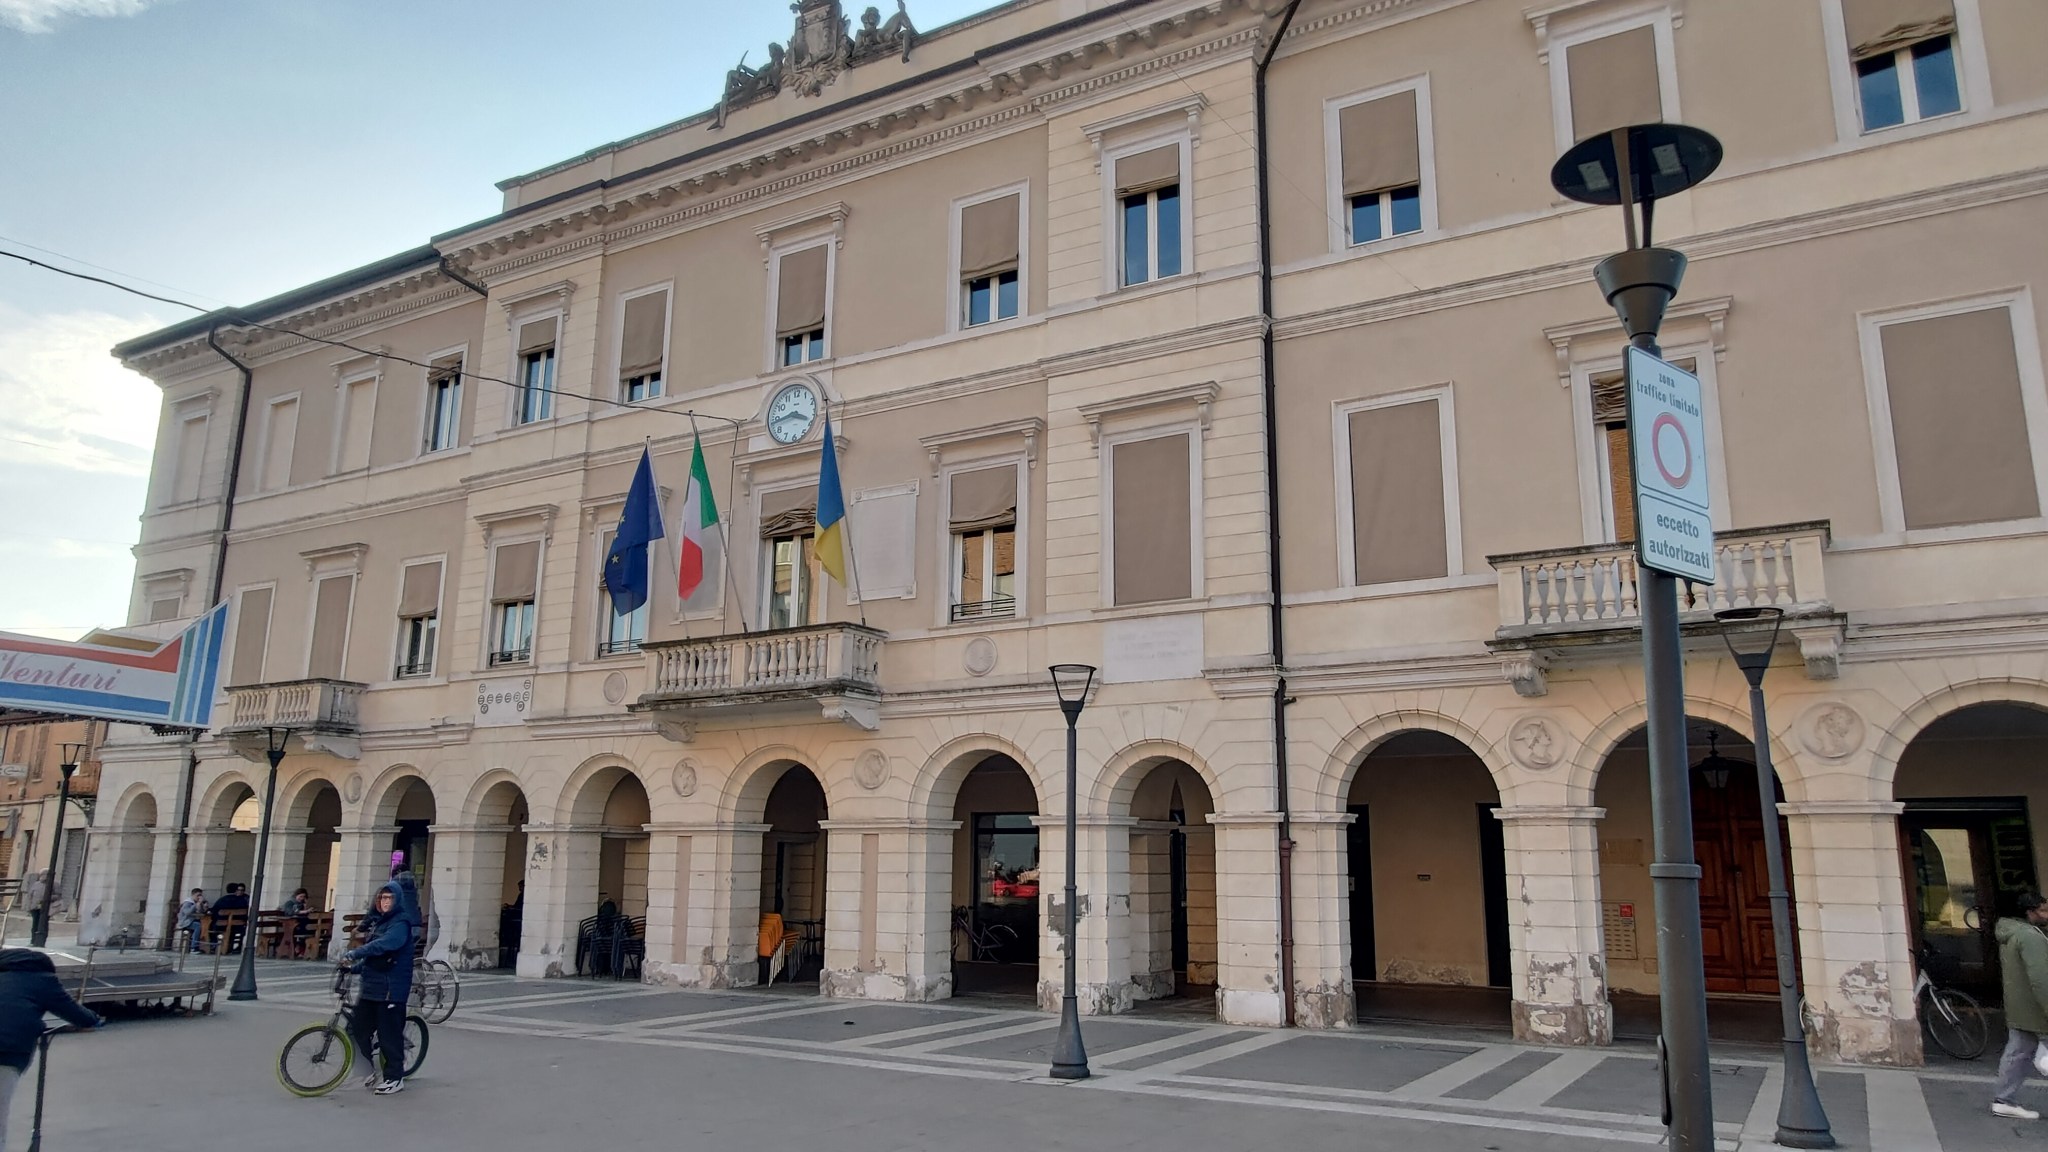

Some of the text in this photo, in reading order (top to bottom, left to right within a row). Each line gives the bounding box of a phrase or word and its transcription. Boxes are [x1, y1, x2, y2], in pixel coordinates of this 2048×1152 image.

[1658, 373, 1675, 388] zona
[793, 390, 800, 398] 12
[1636, 379, 1699, 417] traffico limitato
[777, 426, 782, 434] 8
[1656, 513, 1699, 538] eccetto
[1649, 540, 1710, 570] autorizzati
